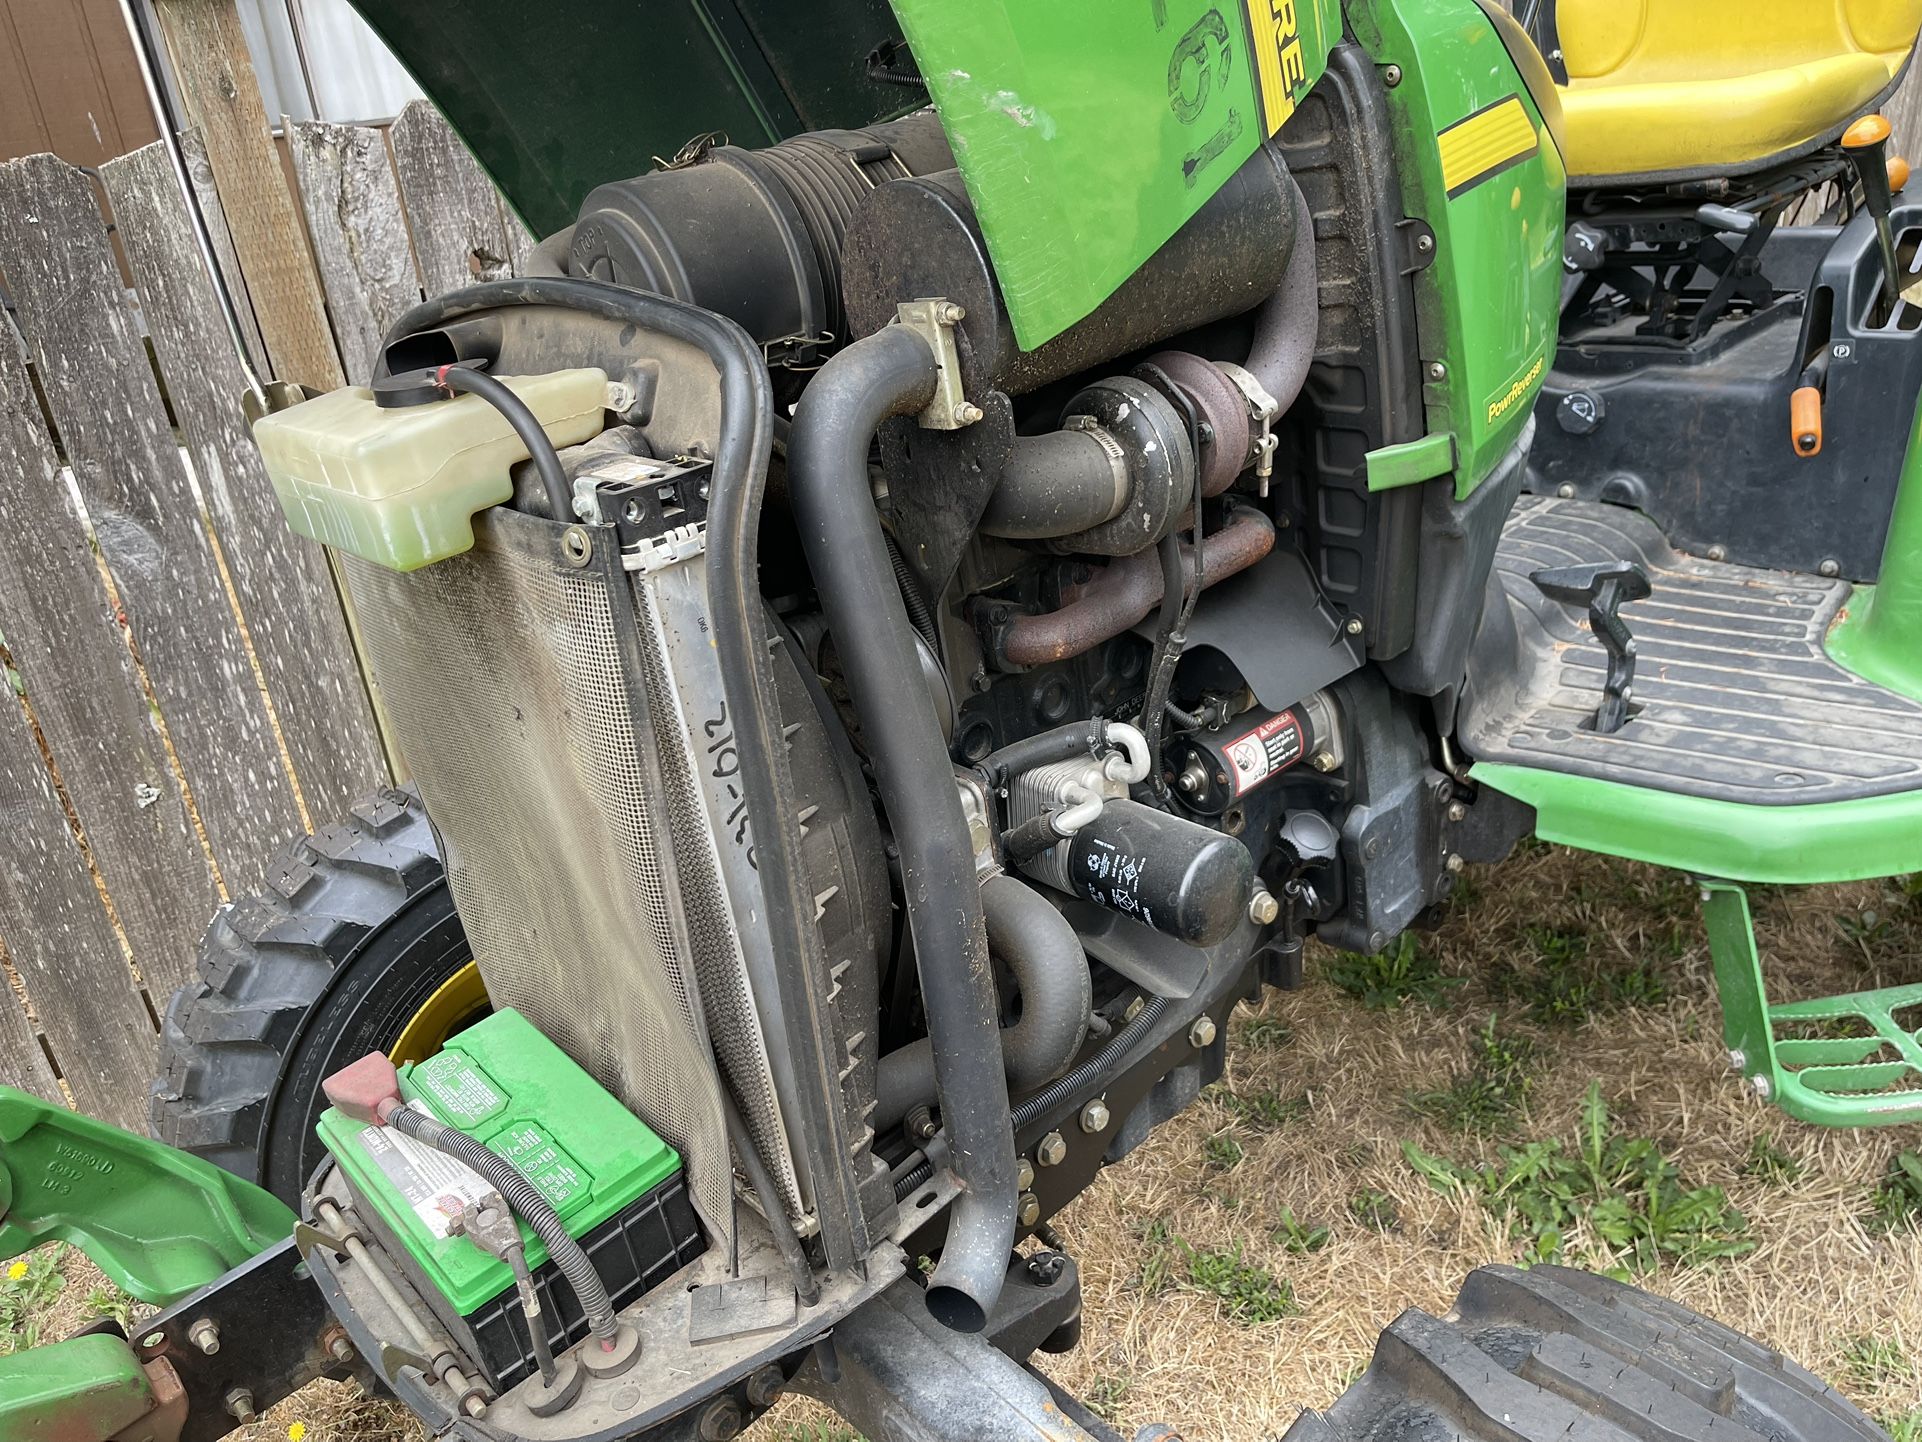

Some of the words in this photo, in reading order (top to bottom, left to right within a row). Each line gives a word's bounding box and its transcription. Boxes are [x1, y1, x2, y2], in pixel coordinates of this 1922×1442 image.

[579, 227, 596, 254] TOP
[1265, 713, 1290, 730] DANGER
[293, 979, 360, 1096] TUBELESS
